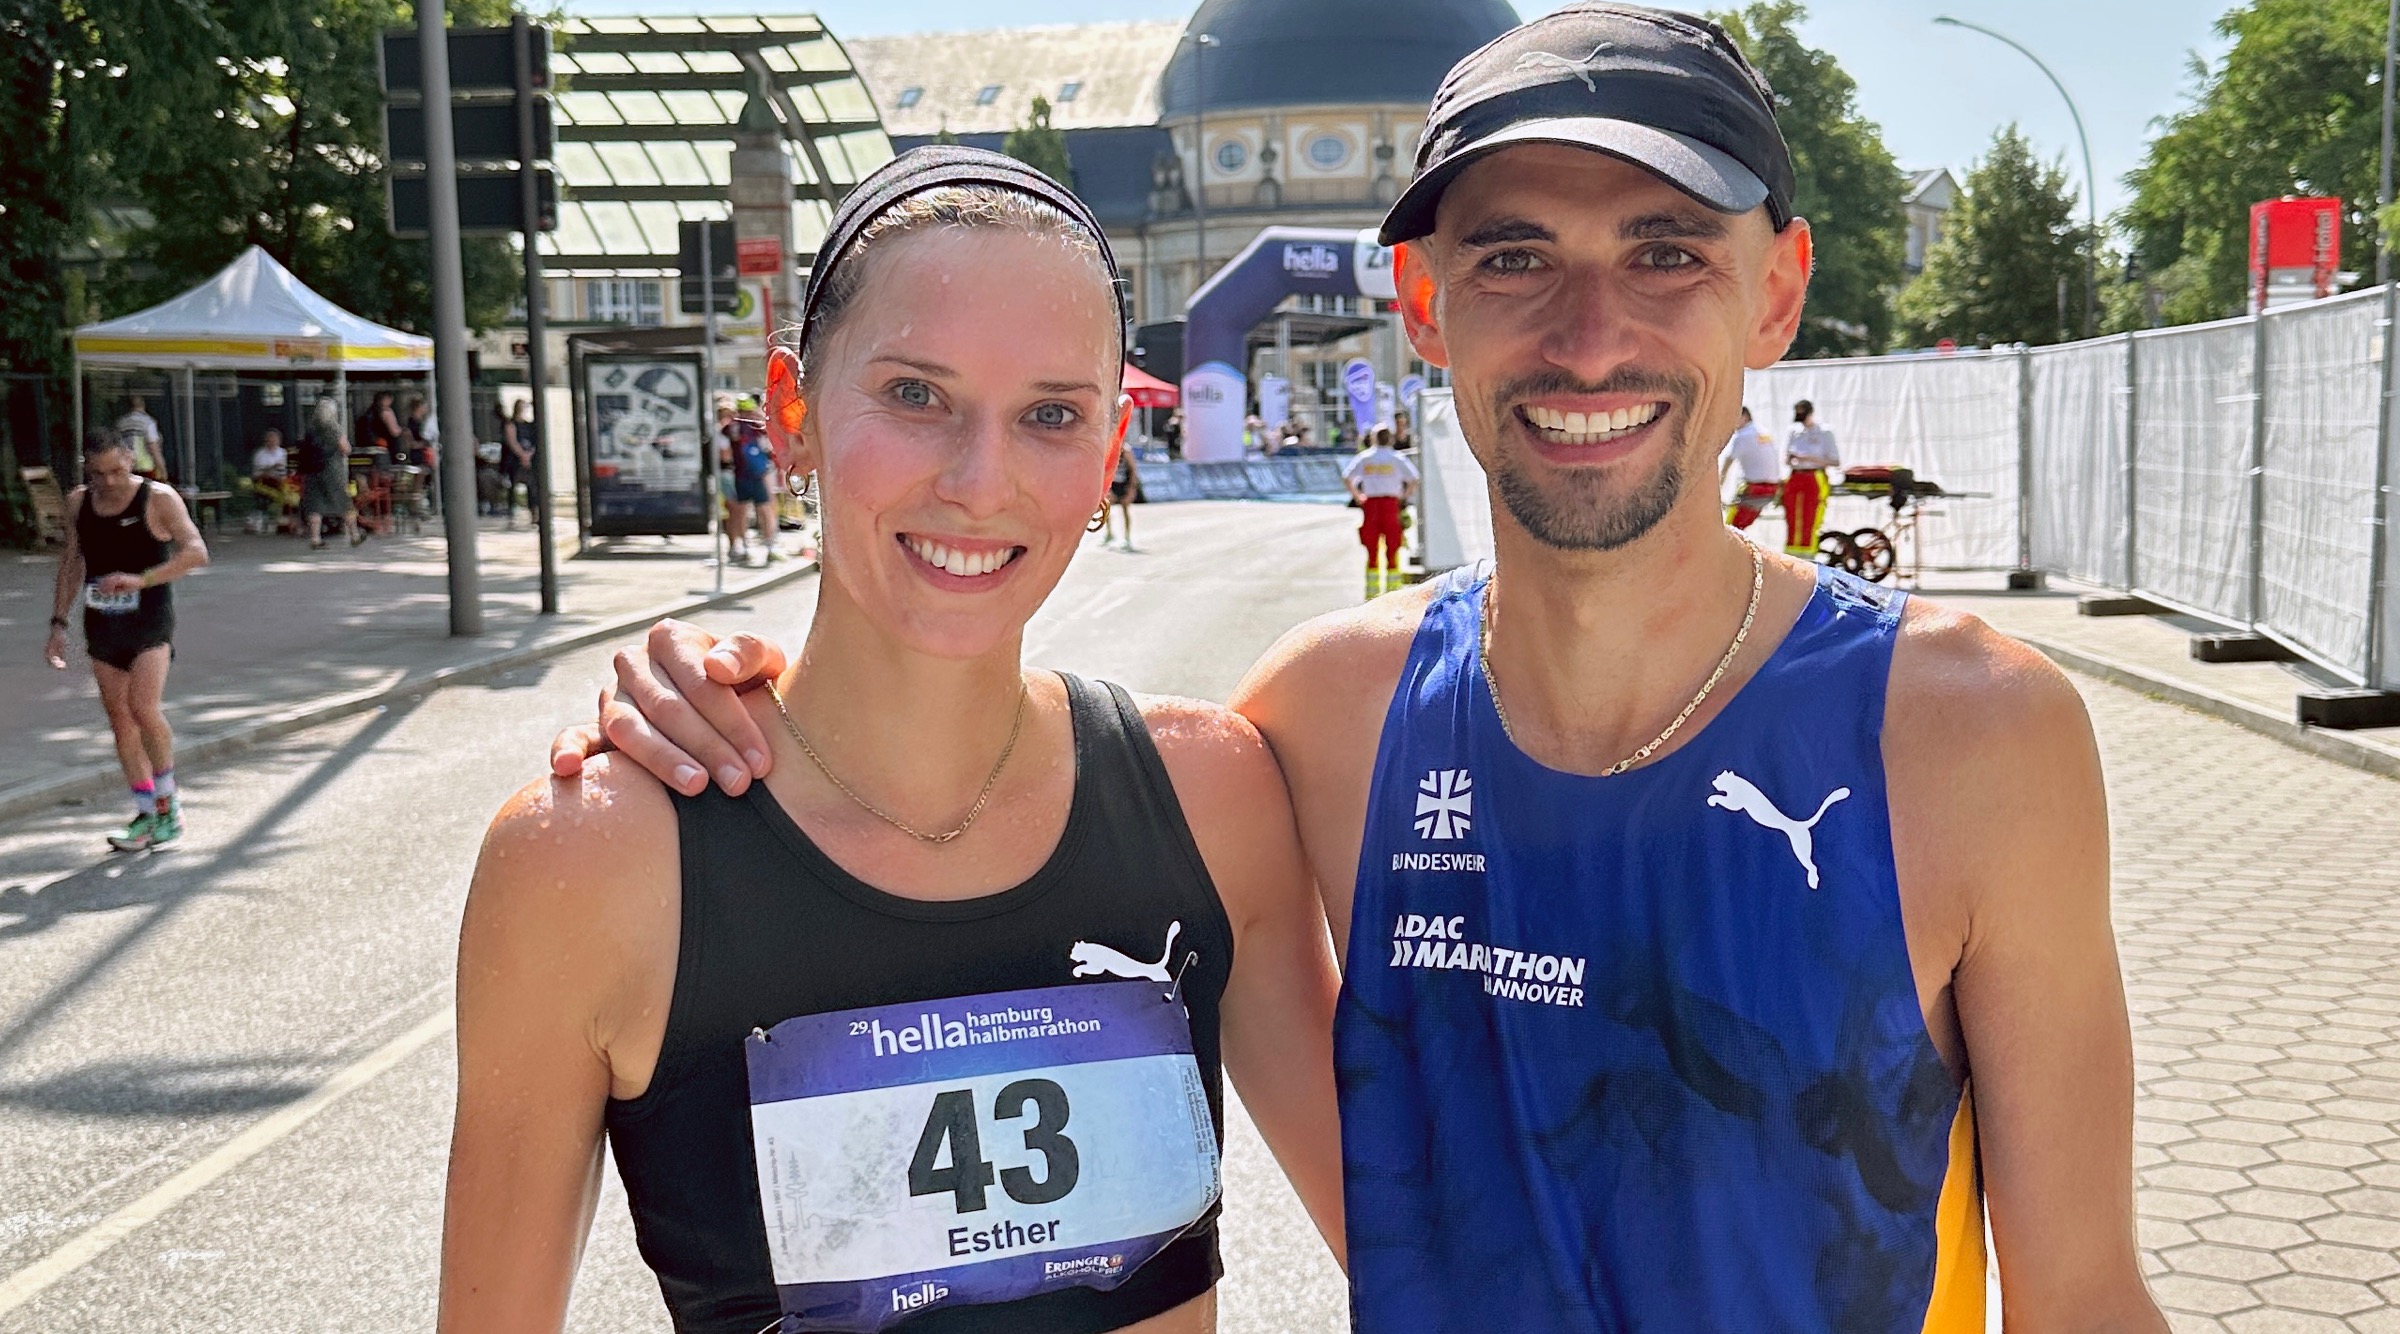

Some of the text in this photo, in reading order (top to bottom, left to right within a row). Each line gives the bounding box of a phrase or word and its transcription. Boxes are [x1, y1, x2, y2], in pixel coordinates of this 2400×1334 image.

[1283, 244, 1338, 271] hella
[1393, 914, 1465, 940] ADAC
[1412, 940, 1586, 985] MARATHON
[1483, 974, 1584, 1007] HNNOVER
[966, 1007, 1053, 1028] hamburg
[969, 1018, 1101, 1045] halbmarathon
[849, 1013, 968, 1057] 29. hella
[907, 1077, 1080, 1214] 43
[947, 1217, 1061, 1257] Esther
[1045, 1255, 1109, 1274] ERDINGER
[1045, 1265, 1123, 1281] ALKOHOLFREI
[892, 1283, 950, 1312] hella
